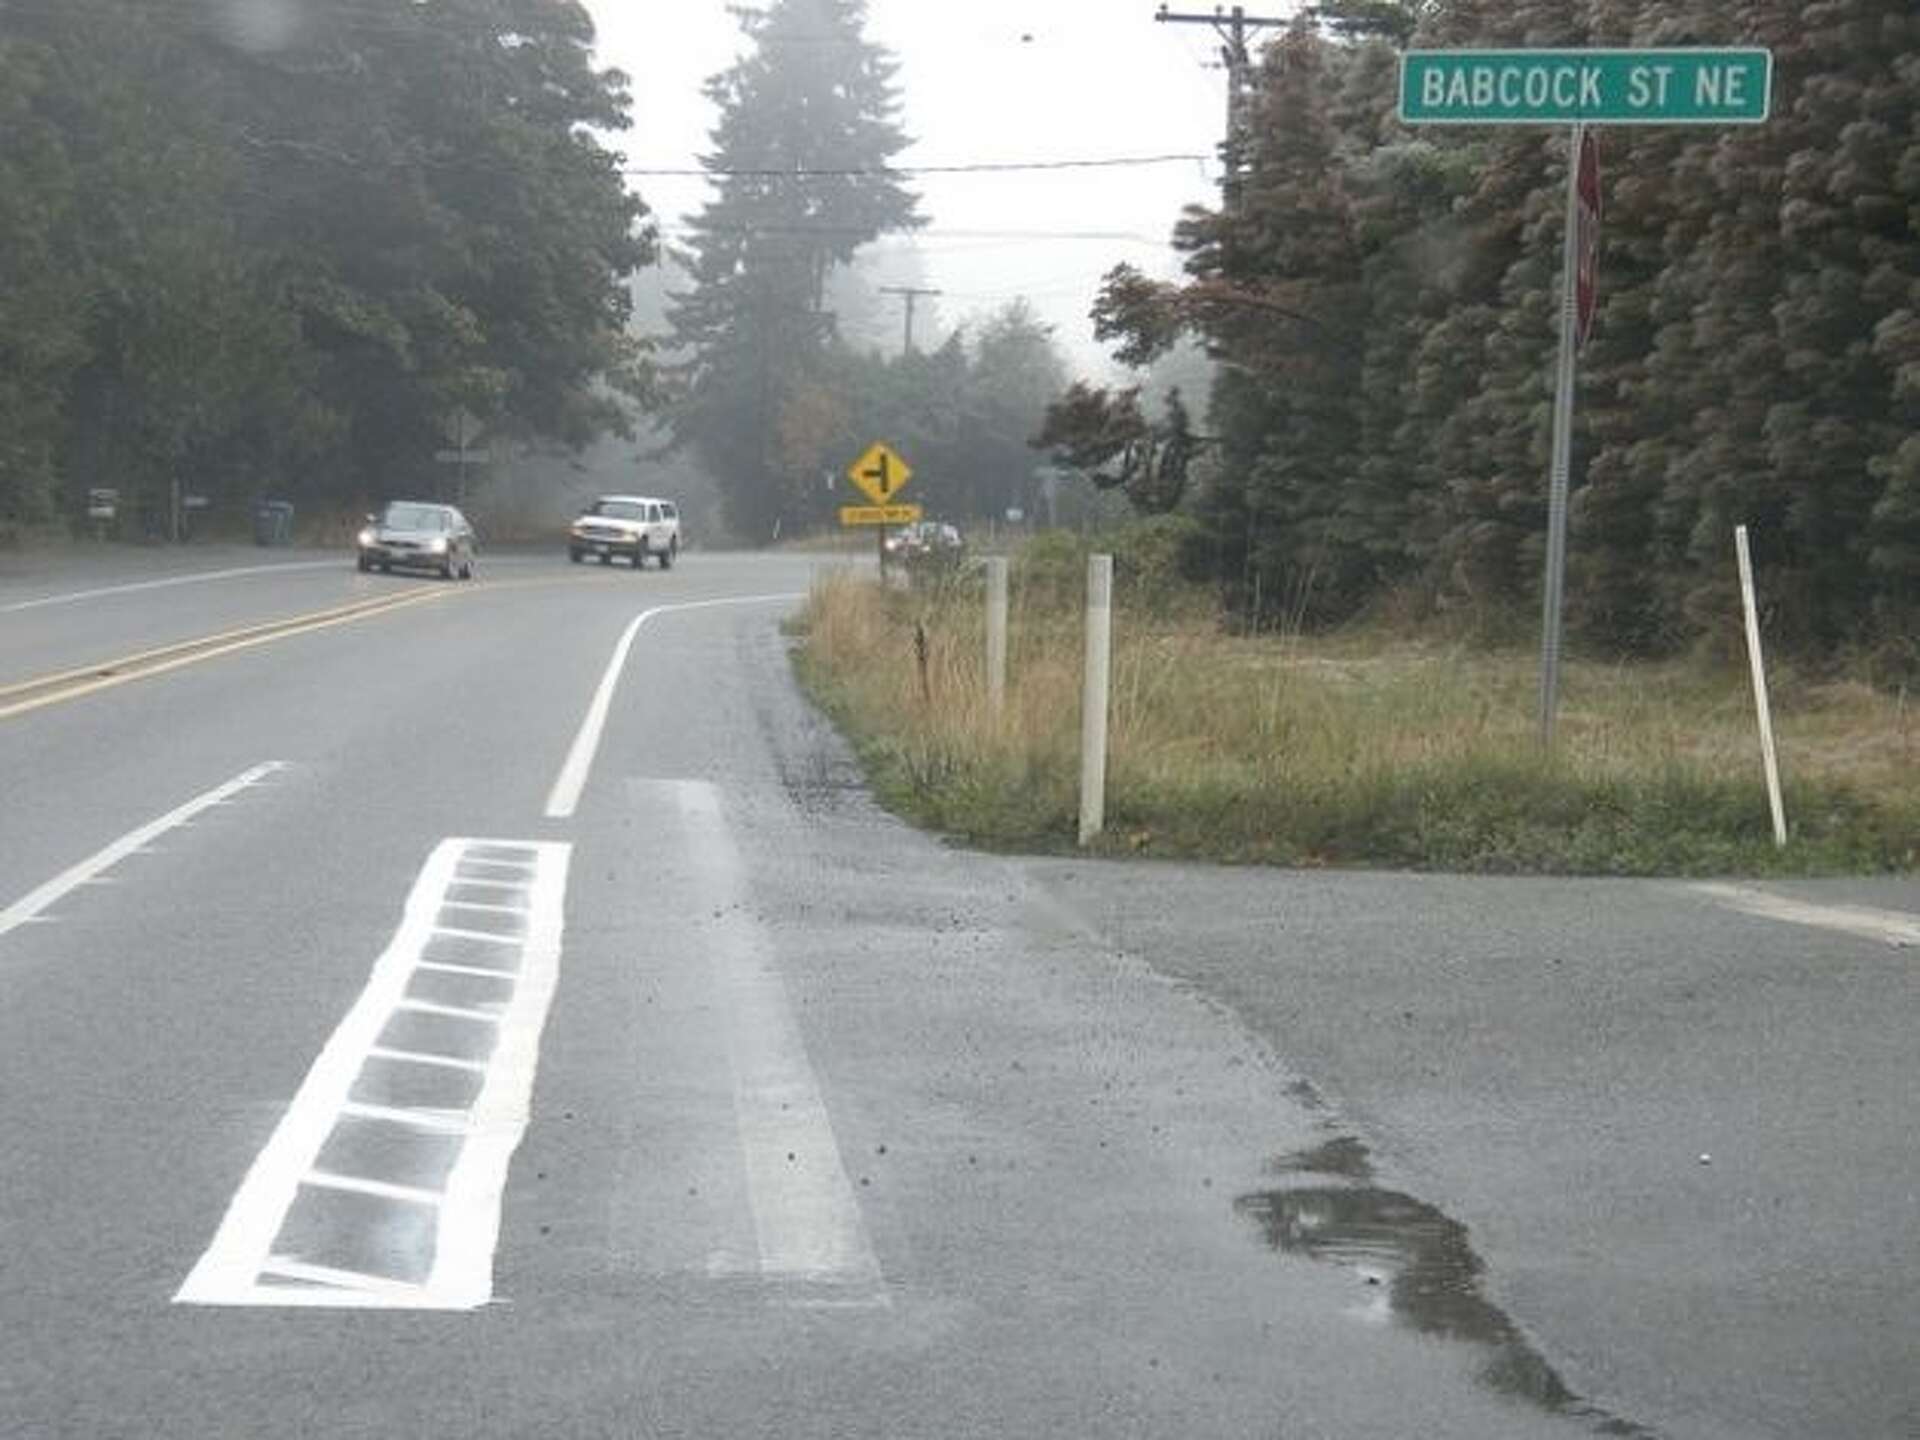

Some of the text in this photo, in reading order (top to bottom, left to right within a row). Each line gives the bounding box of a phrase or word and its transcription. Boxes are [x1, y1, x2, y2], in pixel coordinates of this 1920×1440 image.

[1421, 66, 1747, 106] BABCOCK ST NE
